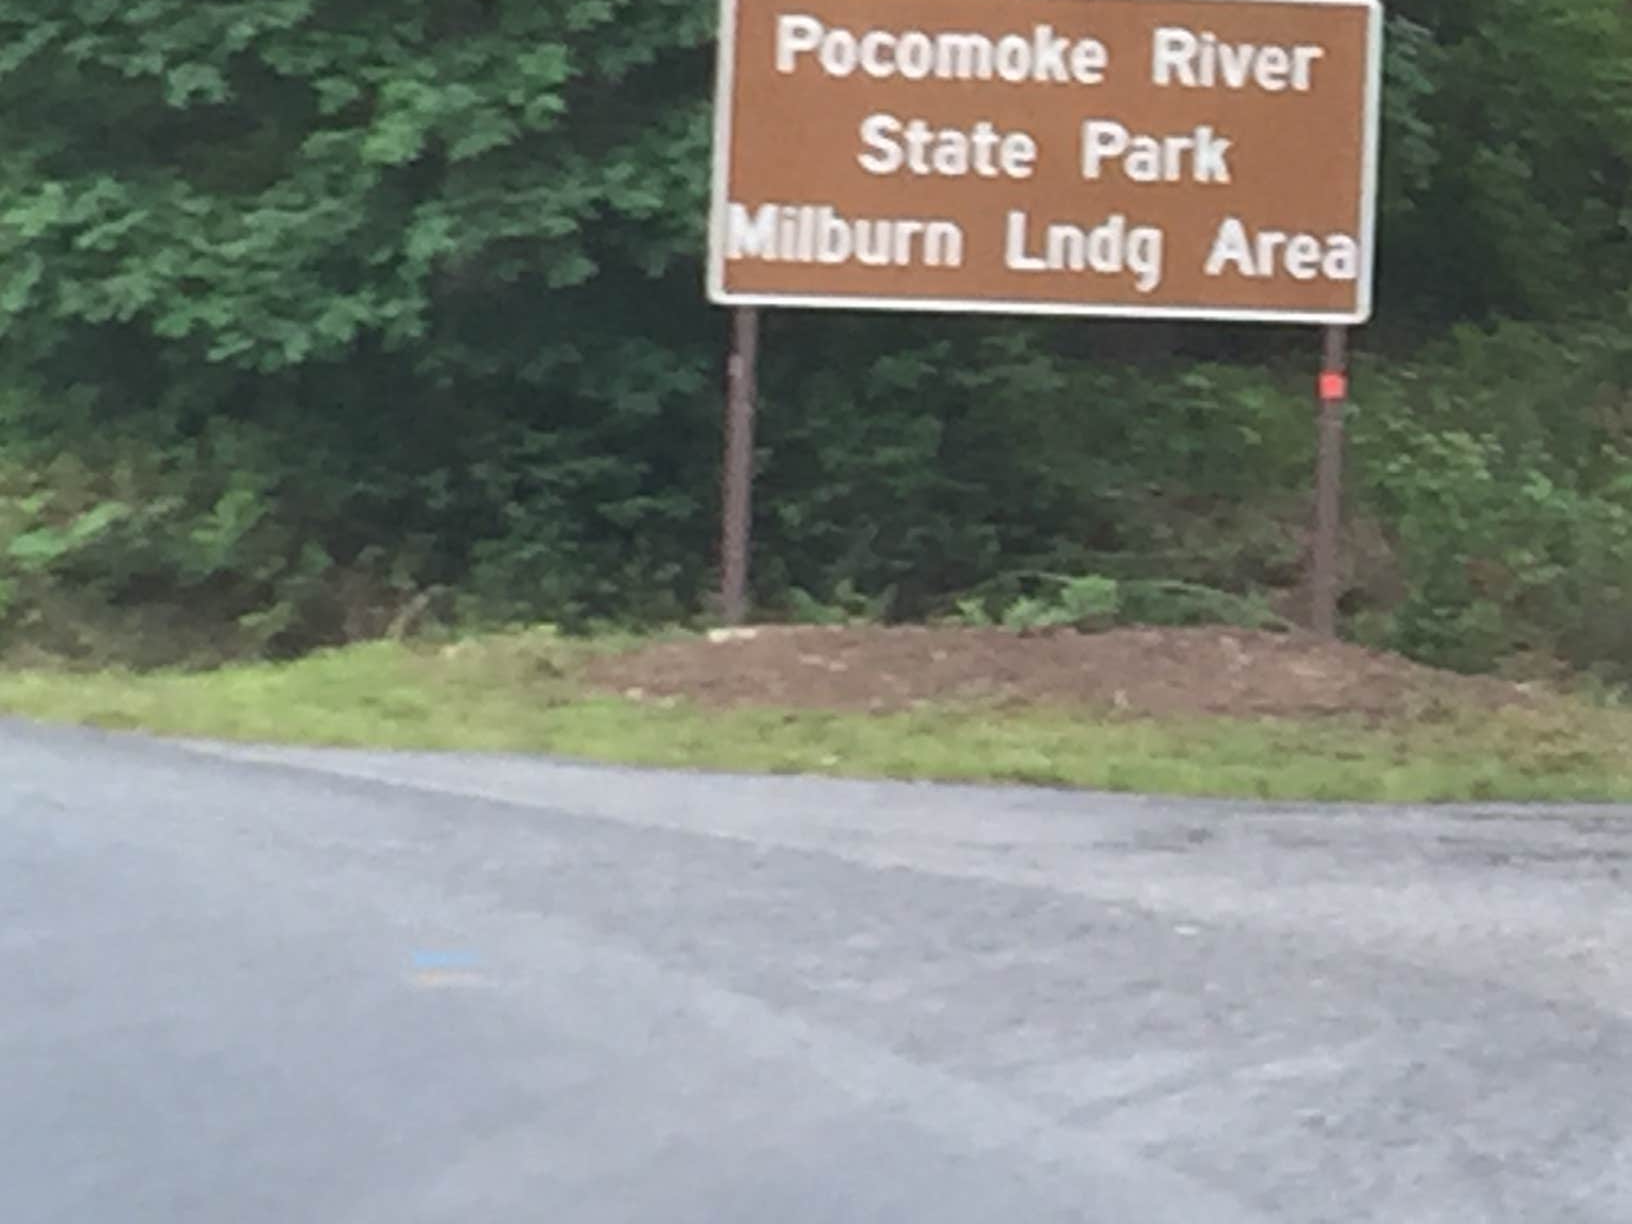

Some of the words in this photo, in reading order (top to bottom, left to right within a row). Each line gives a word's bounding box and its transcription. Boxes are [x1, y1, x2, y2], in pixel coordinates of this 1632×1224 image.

[775, 14, 1108, 84] Pocomoke
[1151, 27, 1323, 91] River
[857, 113, 1037, 178] State
[1081, 120, 1231, 184] Park
[725, 203, 963, 267] Milburn
[1006, 210, 1162, 293] Lndg
[1205, 217, 1359, 280] Area
